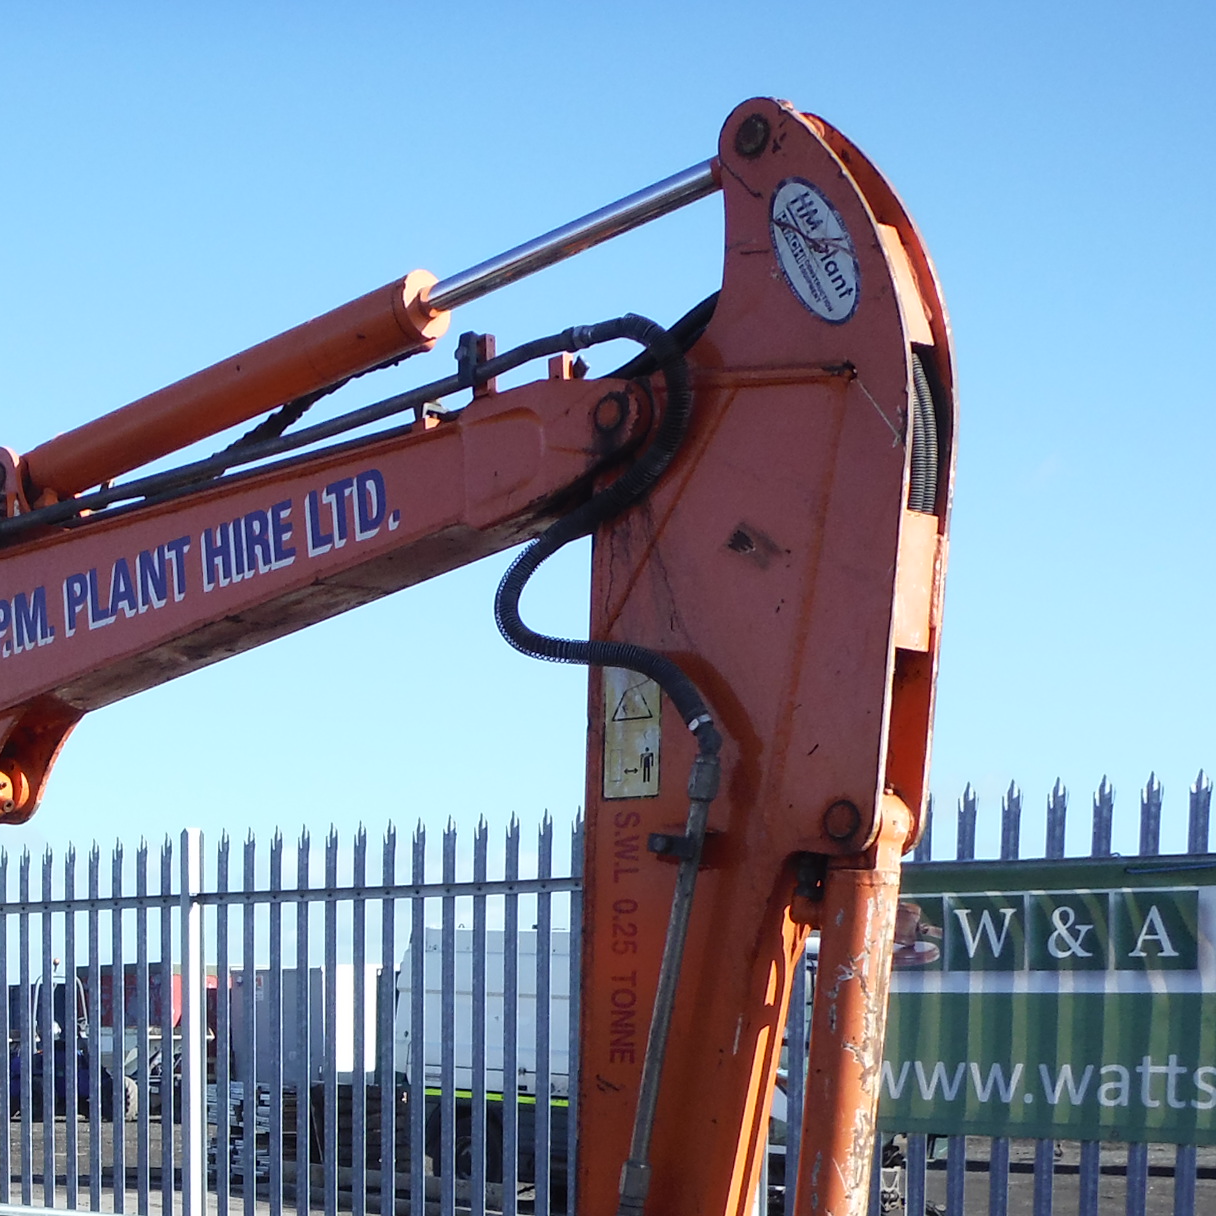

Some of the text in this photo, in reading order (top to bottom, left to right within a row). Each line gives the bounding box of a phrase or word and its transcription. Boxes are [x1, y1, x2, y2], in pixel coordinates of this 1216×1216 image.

[775, 211, 807, 264] HTACHI
[790, 191, 824, 232] HM
[798, 263, 822, 303] EQUIPMENT
[804, 259, 834, 312] CONSTRUCTION
[62, 533, 192, 637] PLANT
[199, 498, 296, 593] HIRE
[304, 467, 401, 558] LTD.
[611, 898, 639, 955] 0.25
[952, 904, 1180, 959] W & A
[609, 970, 637, 1065] TONNE
